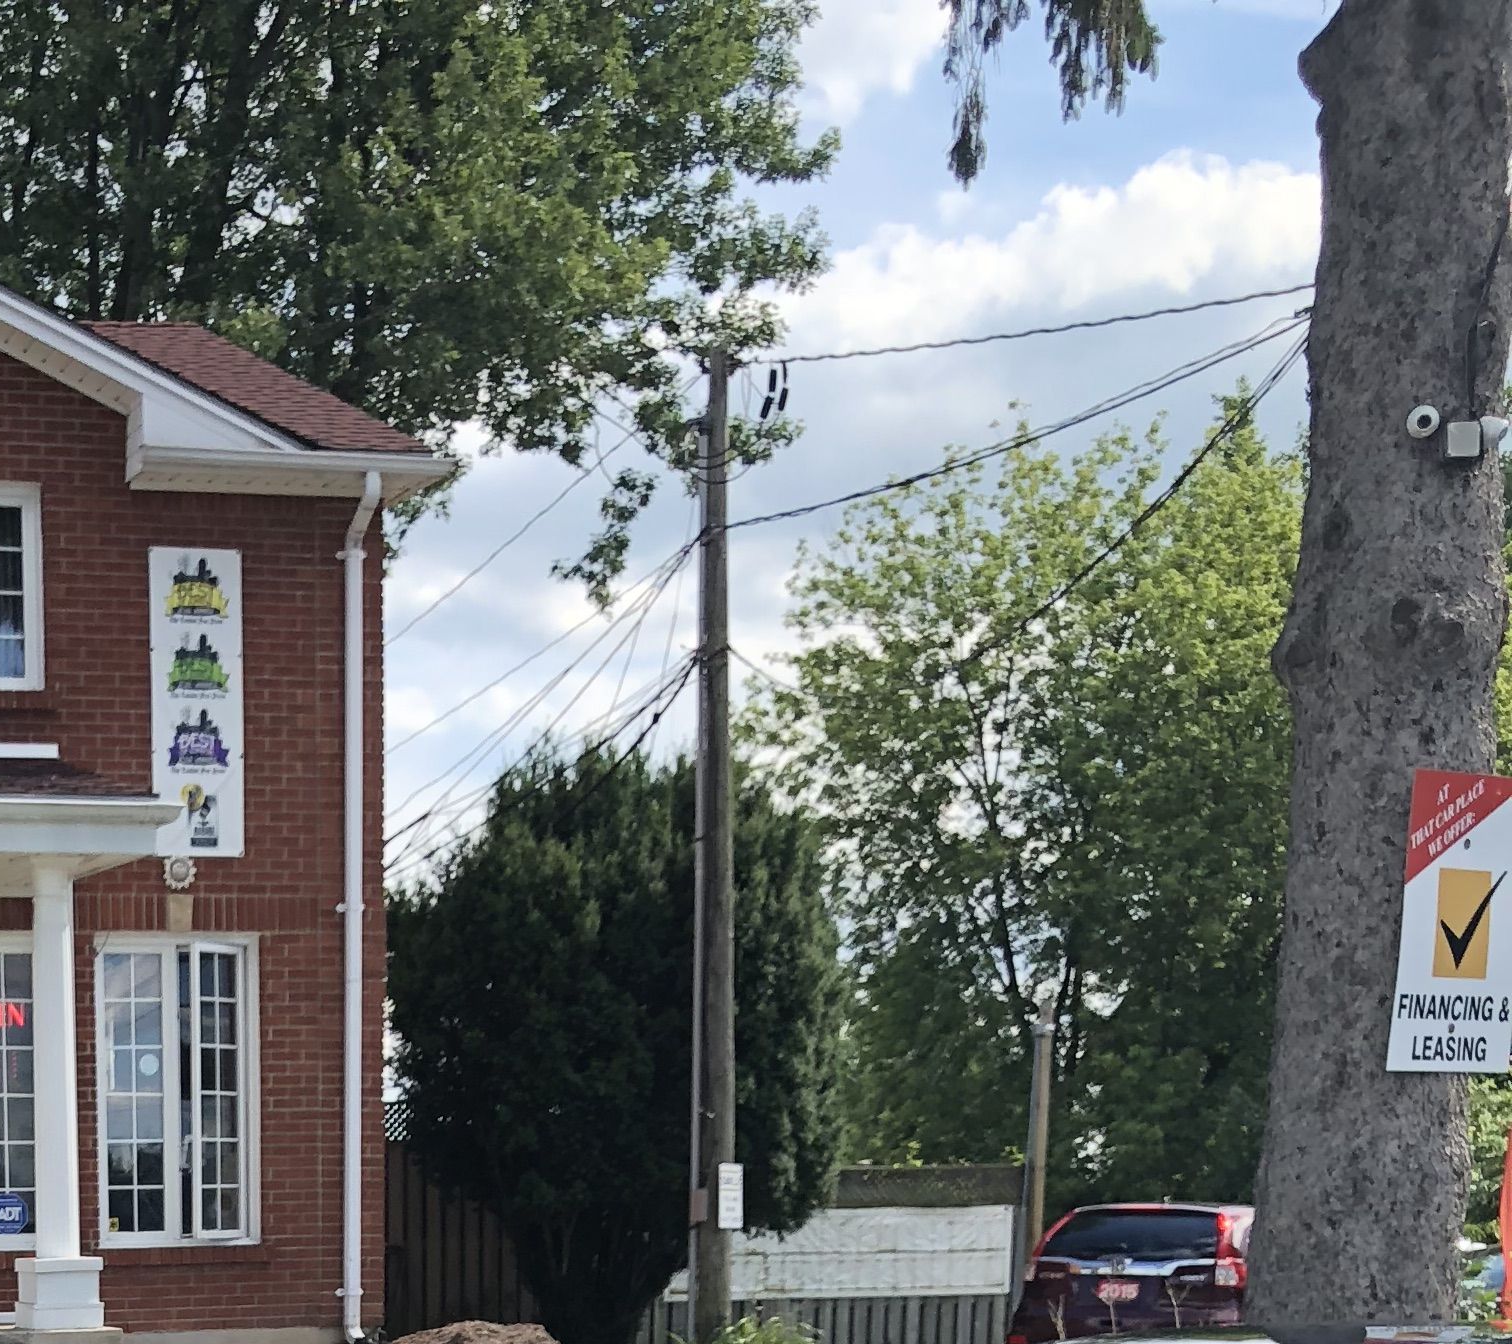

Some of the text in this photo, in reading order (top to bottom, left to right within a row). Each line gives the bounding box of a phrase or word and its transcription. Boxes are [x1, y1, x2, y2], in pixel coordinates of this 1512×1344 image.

[1437, 783, 1450, 806] AT
[1410, 779, 1485, 849] THAT CAR PLACE
[1428, 812, 1476, 857] WE OFFER:
[1397, 993, 1510, 1023] FINANCING &
[1411, 1035, 1487, 1062] LEASING
